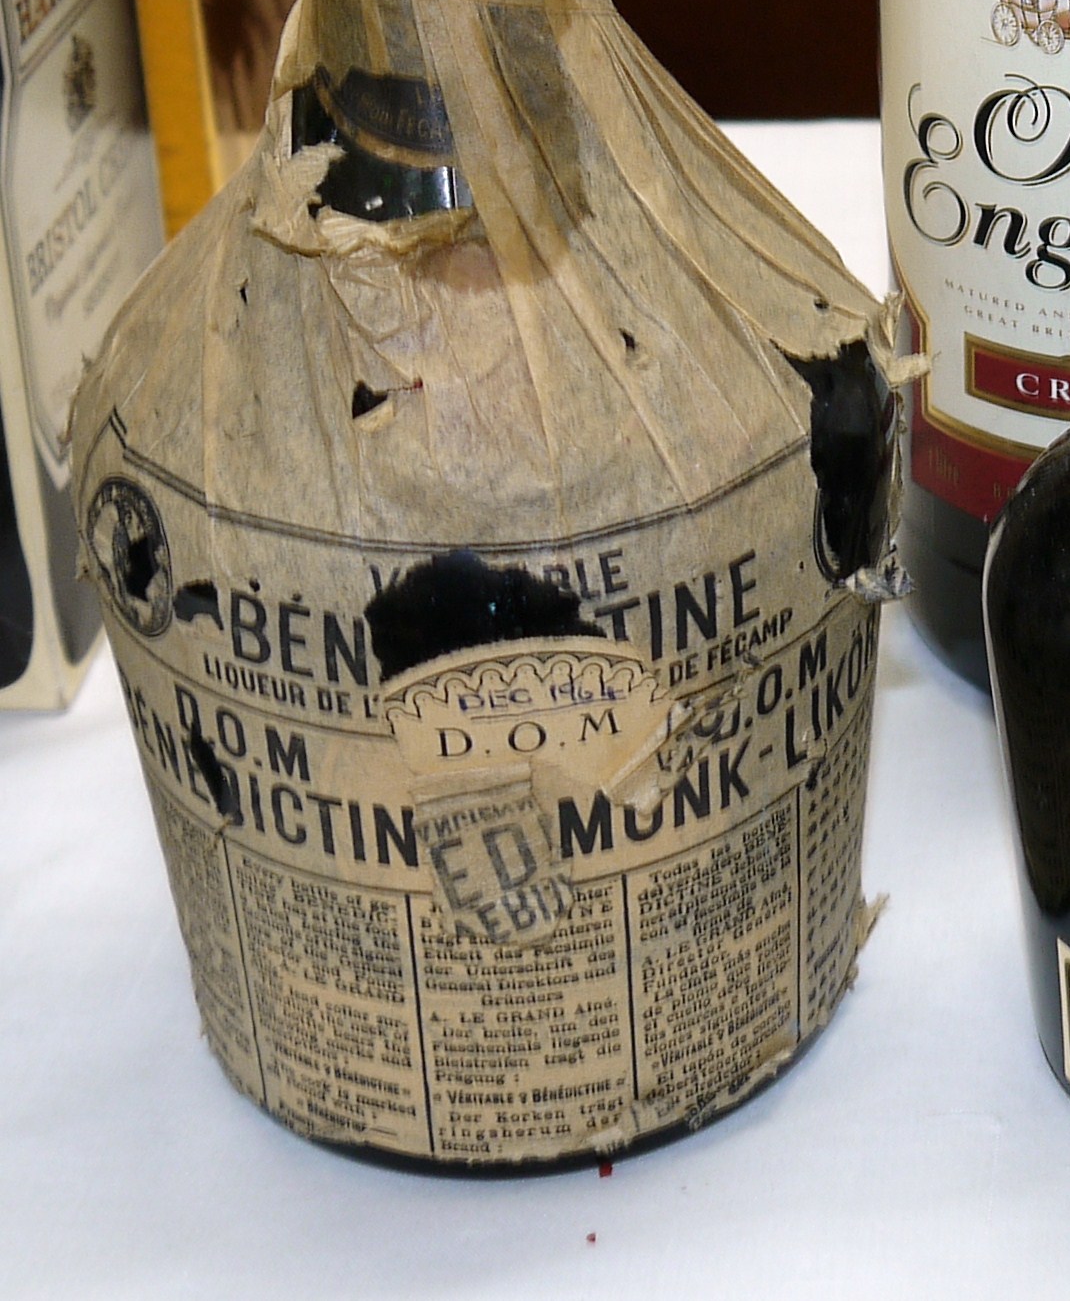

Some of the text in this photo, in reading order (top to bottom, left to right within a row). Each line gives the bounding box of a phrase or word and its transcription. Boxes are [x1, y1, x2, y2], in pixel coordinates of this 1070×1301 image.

[944, 277, 1025, 312] MATURED
[964, 305, 1019, 329] GREAT
[230, 549, 760, 687] BÉNTINE
[203, 652, 305, 707] LIQUEUR
[317, 697, 353, 716] DE
[668, 653, 699, 687] DE
[707, 607, 793, 671] FÉCAMP
[459, 1011, 485, 1024] LE
[496, 1006, 565, 1024] GRAND
[495, 1109, 566, 1124] Korken
